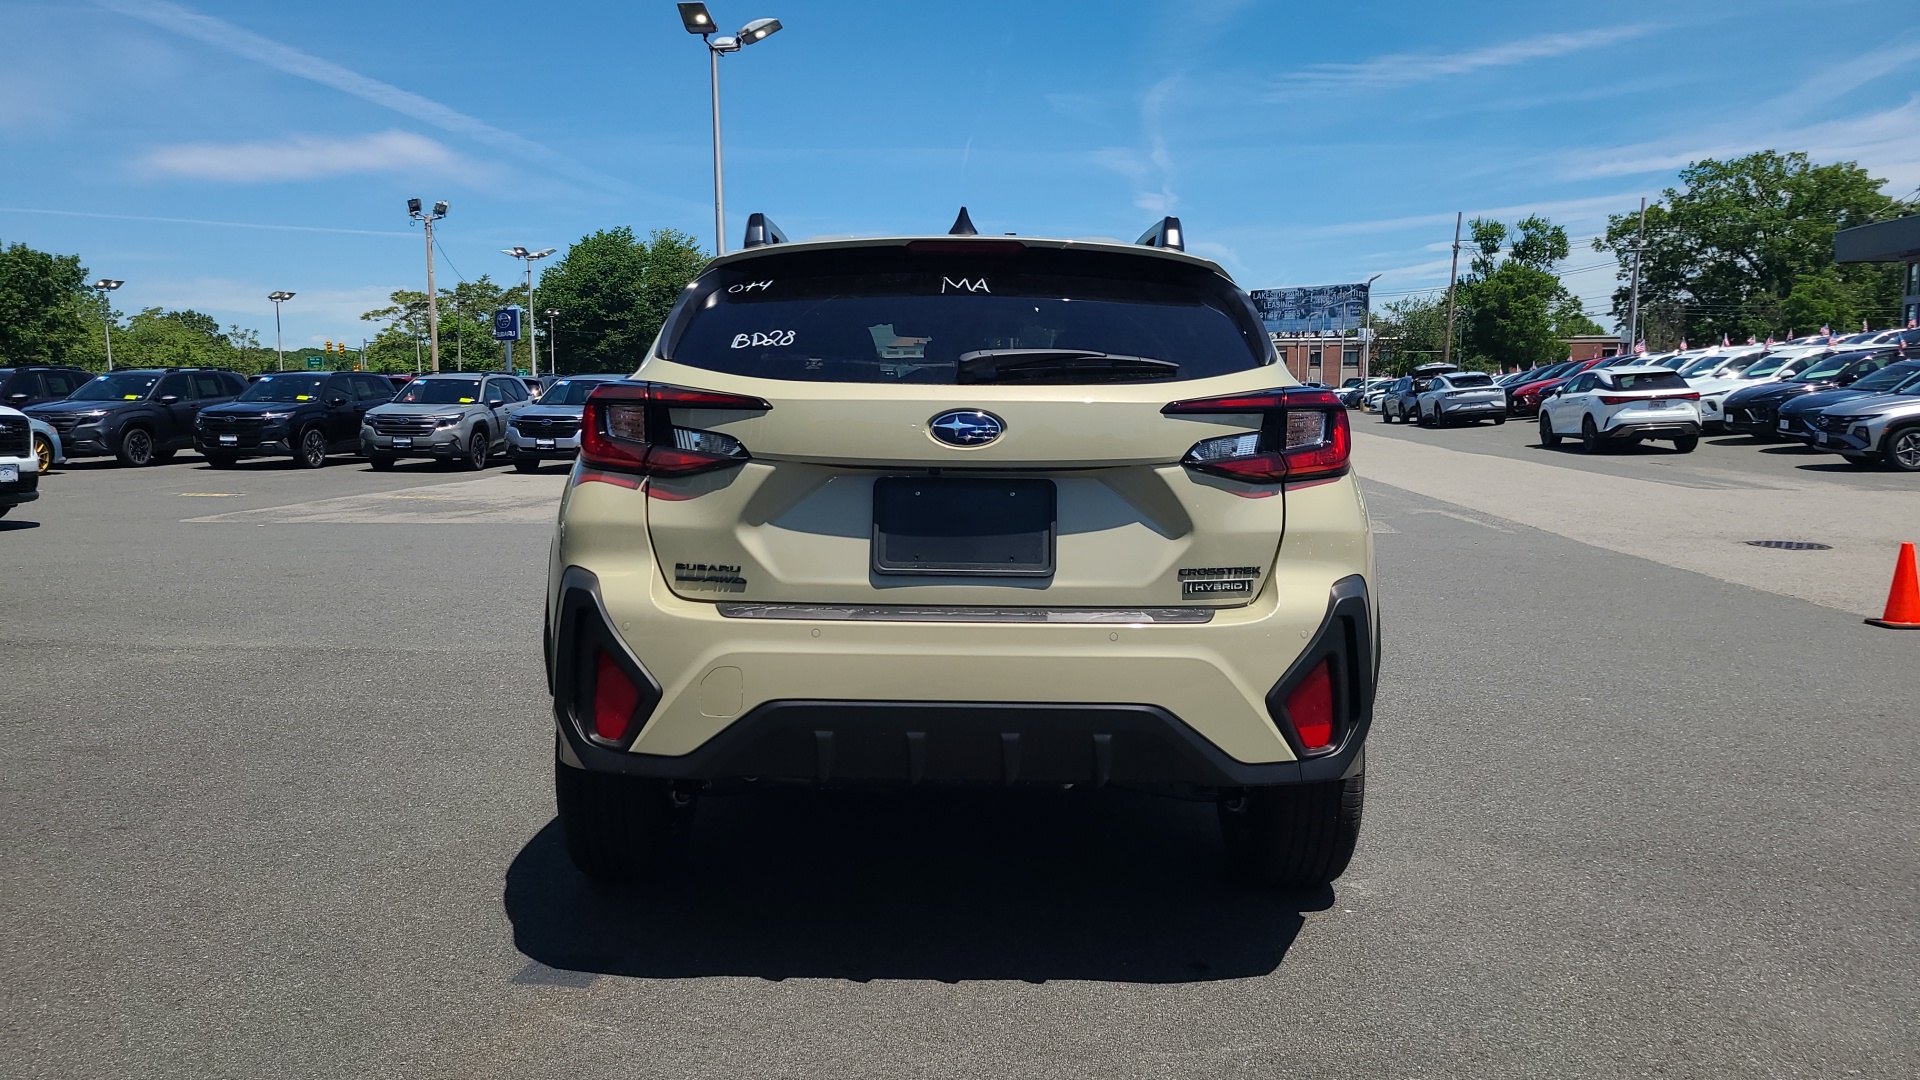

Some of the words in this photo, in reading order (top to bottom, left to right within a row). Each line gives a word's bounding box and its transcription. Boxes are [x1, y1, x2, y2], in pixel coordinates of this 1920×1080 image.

[941, 276, 992, 294] MA
[1252, 291, 1285, 300] LAKESIDE
[1263, 300, 1293, 309] LEASING
[675, 563, 741, 572] SUBARU
[1178, 566, 1261, 576] CROSSTREK
[1195, 583, 1243, 591] HYBRID
